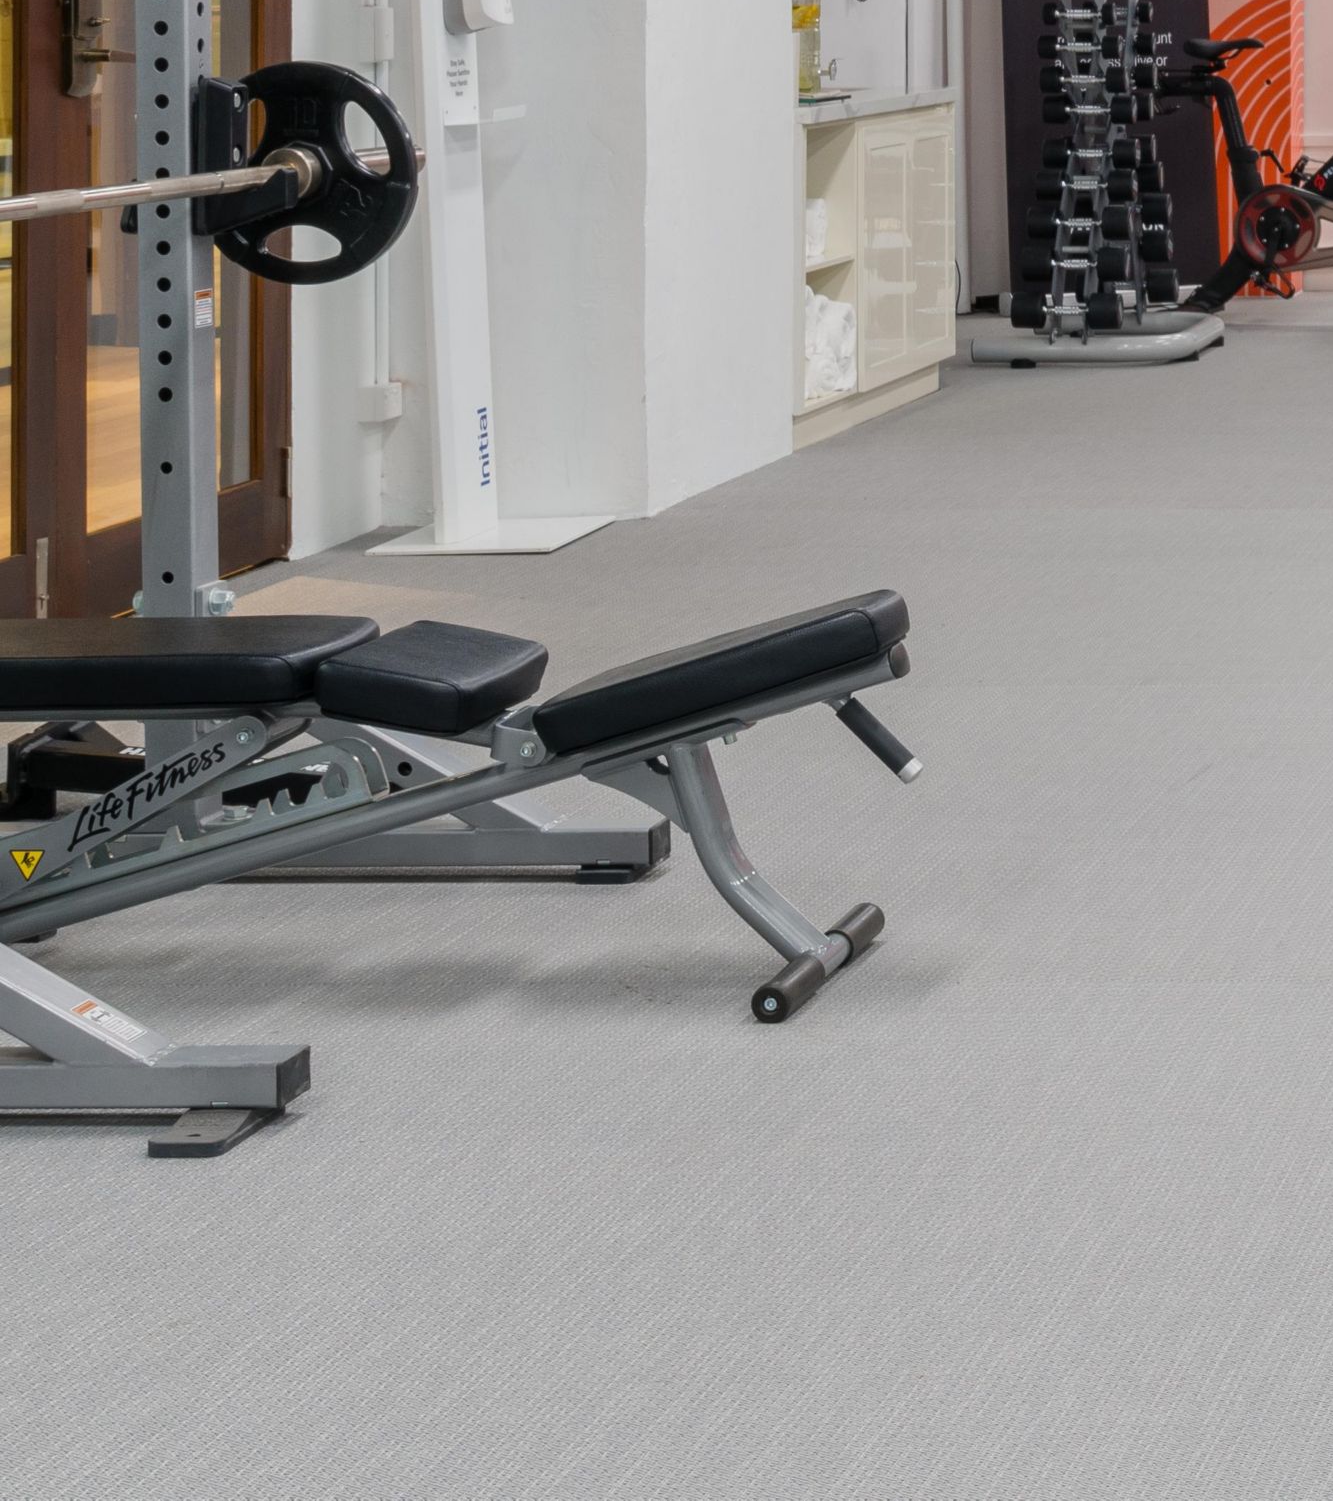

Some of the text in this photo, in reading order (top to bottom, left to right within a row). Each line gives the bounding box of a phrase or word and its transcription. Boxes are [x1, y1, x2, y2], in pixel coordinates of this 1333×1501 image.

[1154, 54, 1169, 67] or
[477, 406, 490, 487] Initial
[67, 742, 226, 852] Life Fitness
